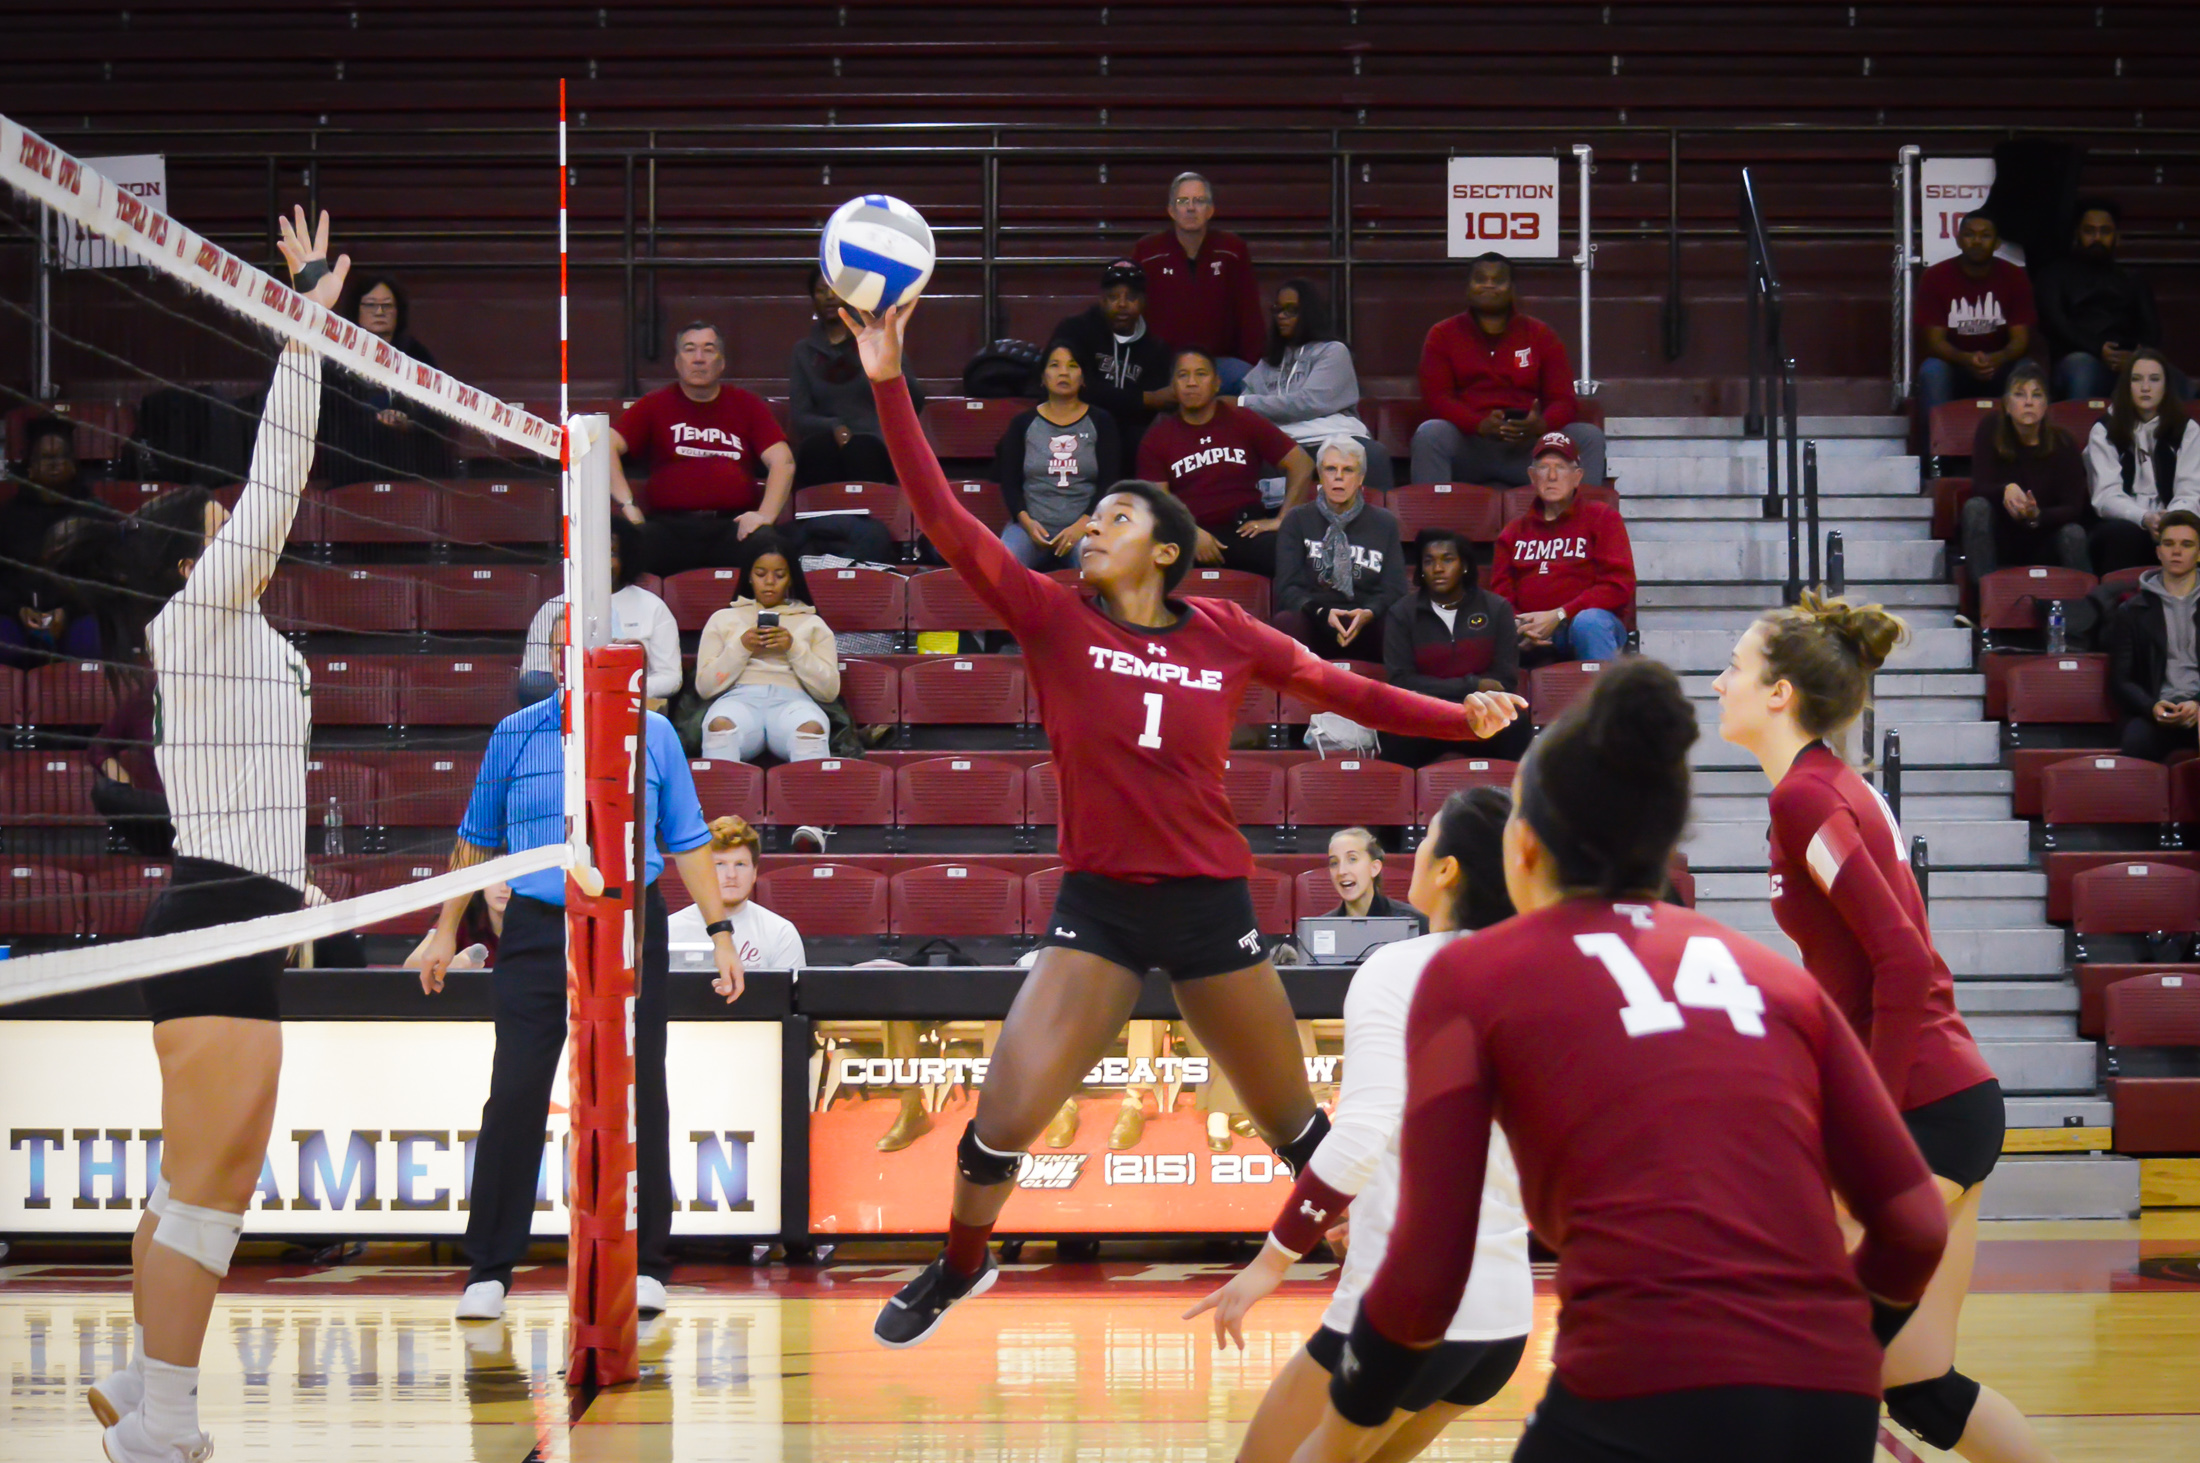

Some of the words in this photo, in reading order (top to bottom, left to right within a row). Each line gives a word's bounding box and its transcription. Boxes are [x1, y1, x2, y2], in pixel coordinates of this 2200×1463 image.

[1453, 184, 1553, 199] SECTION
[1926, 184, 1992, 199] SECT
[1465, 212, 1540, 240] 103
[1514, 347, 1531, 368] T
[670, 422, 744, 451] TEMPLE
[1171, 447, 1247, 478] TEMPLE
[1514, 537, 1587, 561] TEMPLE
[1088, 645, 1223, 691] TEMPLE
[1138, 692, 1163, 749] 1
[1238, 928, 1261, 955] T
[1573, 932, 1766, 1038] 14
[840, 1057, 990, 1084] COURTS
[1083, 1057, 1209, 1084] SEATS
[1034, 1154, 1088, 1162] TEMPLE
[1104, 1152, 1196, 1186] (215)
[1019, 1179, 1073, 1189] CLUB
